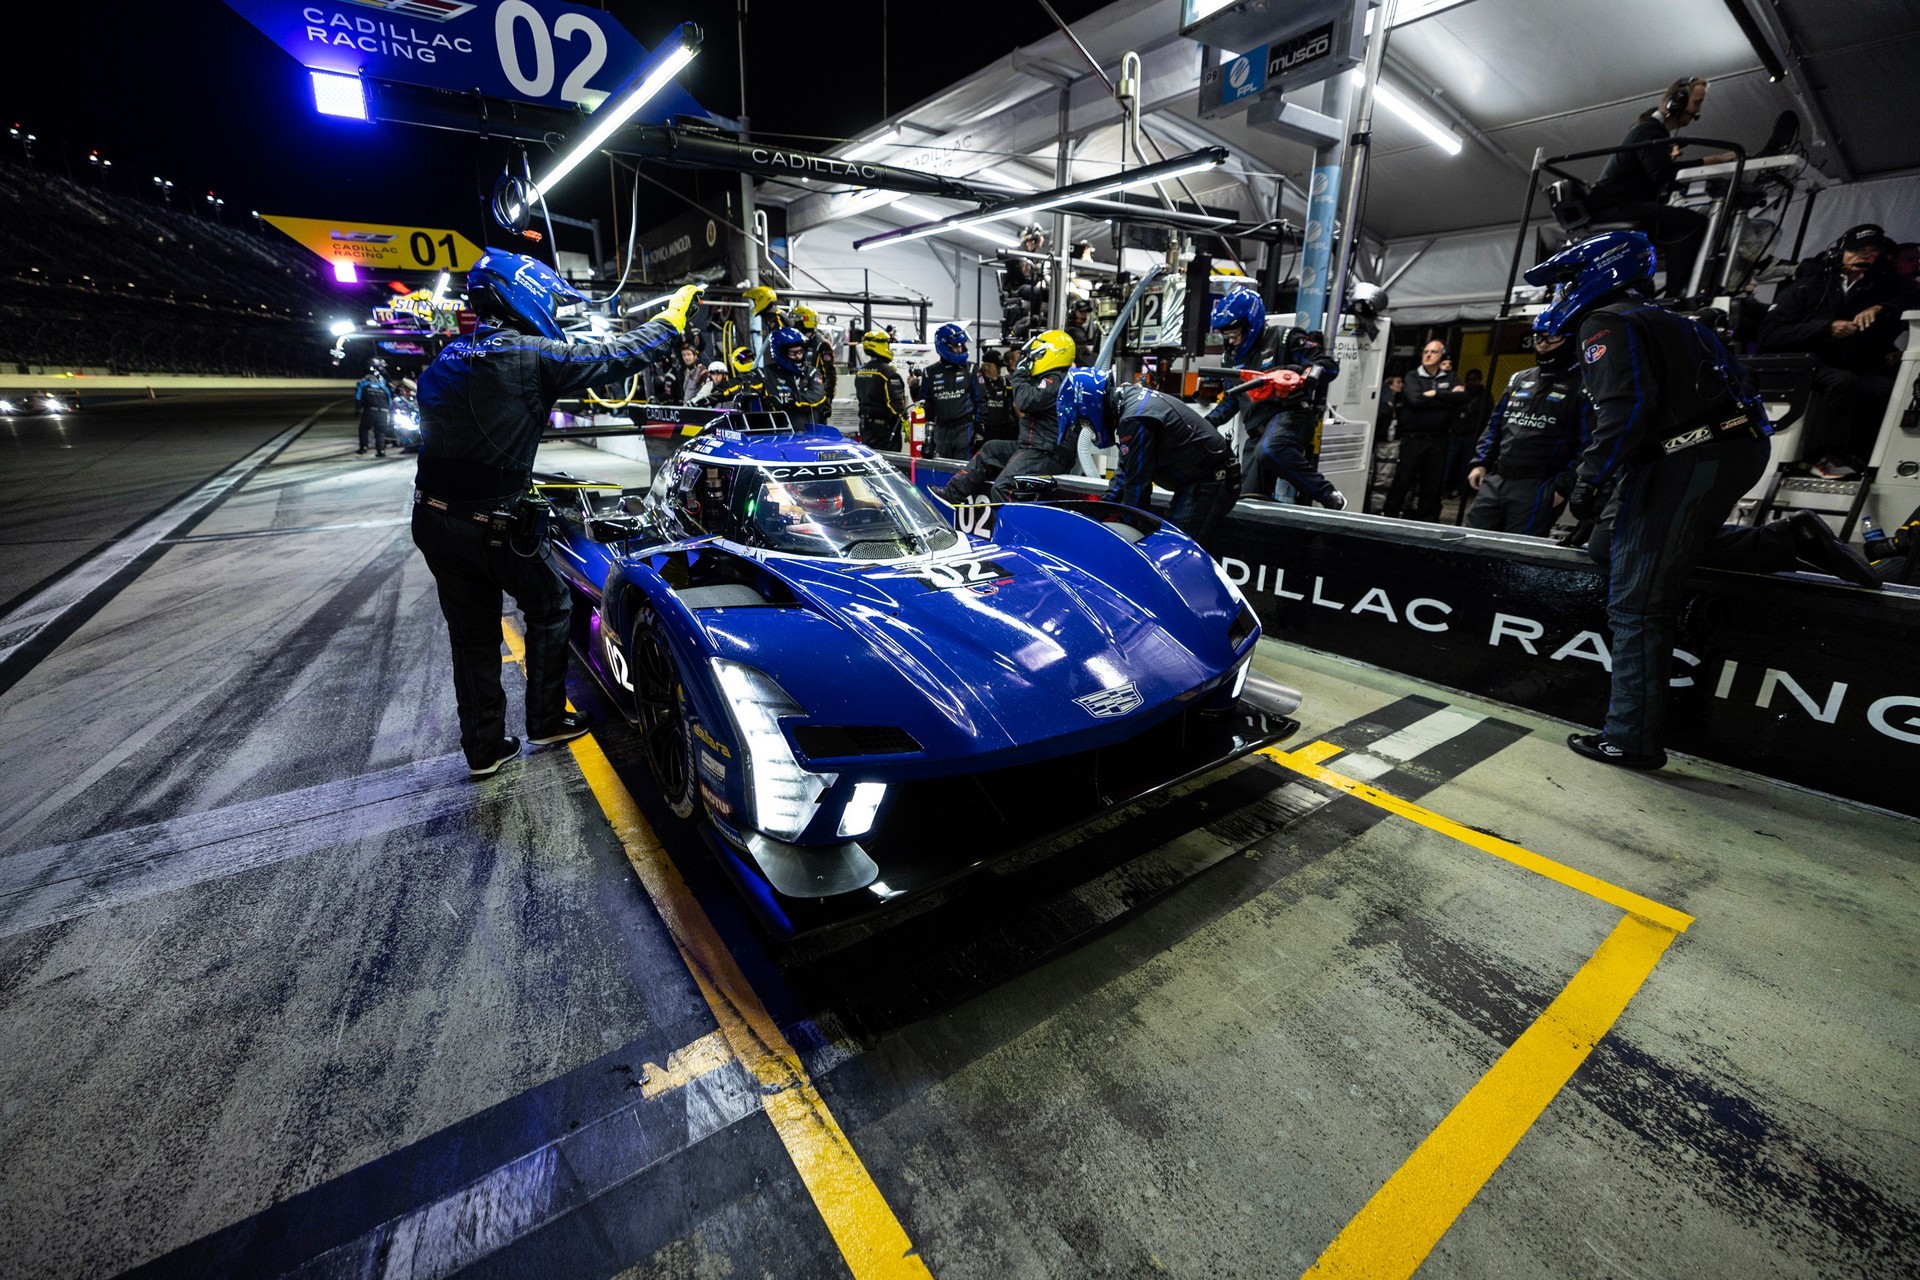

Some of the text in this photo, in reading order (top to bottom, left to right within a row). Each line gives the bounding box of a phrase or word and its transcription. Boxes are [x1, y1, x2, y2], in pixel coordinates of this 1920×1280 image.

[303, 8, 473, 53] CADILLAC
[306, 26, 436, 63] RACING
[494, 0, 611, 114] 02
[1269, 37, 1329, 73] MUSCO
[1205, 70, 1218, 85] P9
[1237, 83, 1258, 99] FPL
[752, 149, 876, 180] CADILLAC
[1314, 195, 1335, 204] FPL
[332, 243, 399, 254] CADILLAC
[410, 231, 459, 268] 01
[1309, 242, 1329, 250] FPL
[334, 250, 384, 259] RACING
[1303, 287, 1323, 296] FPL
[1335, 342, 1370, 351] DILLAC
[646, 408, 680, 423] CADILLAC
[1222, 557, 1452, 633] DILLAC
[605, 636, 635, 693] 02
